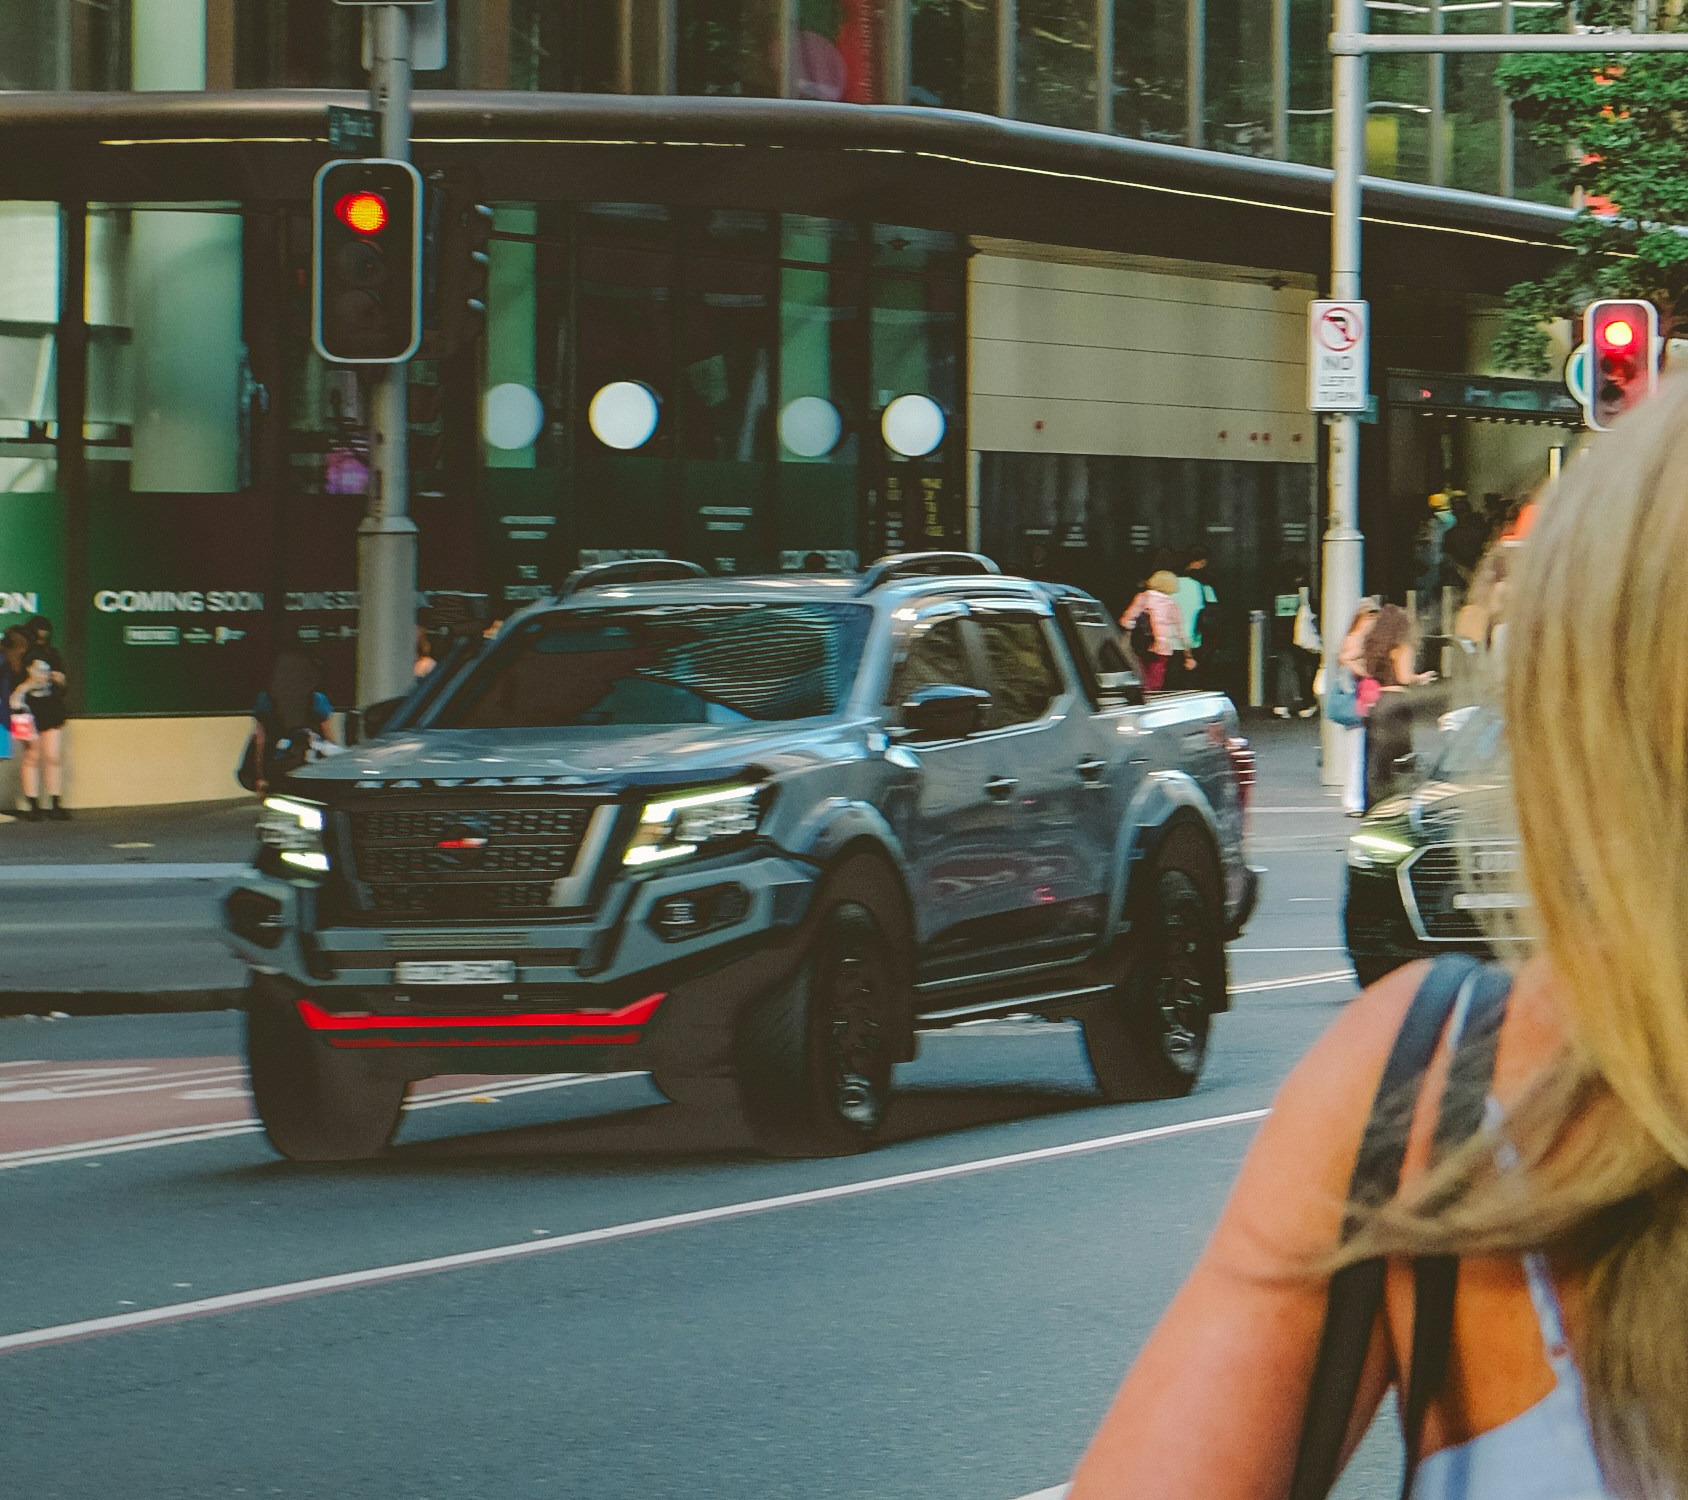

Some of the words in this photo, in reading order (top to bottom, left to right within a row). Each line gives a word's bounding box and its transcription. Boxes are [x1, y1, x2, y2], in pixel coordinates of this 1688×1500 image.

[1321, 355, 1354, 371] NO
[1319, 375, 1357, 387] LEFT
[1318, 391, 1361, 402] TURN
[94, 590, 204, 613] COMING
[206, 590, 264, 612] SOON
